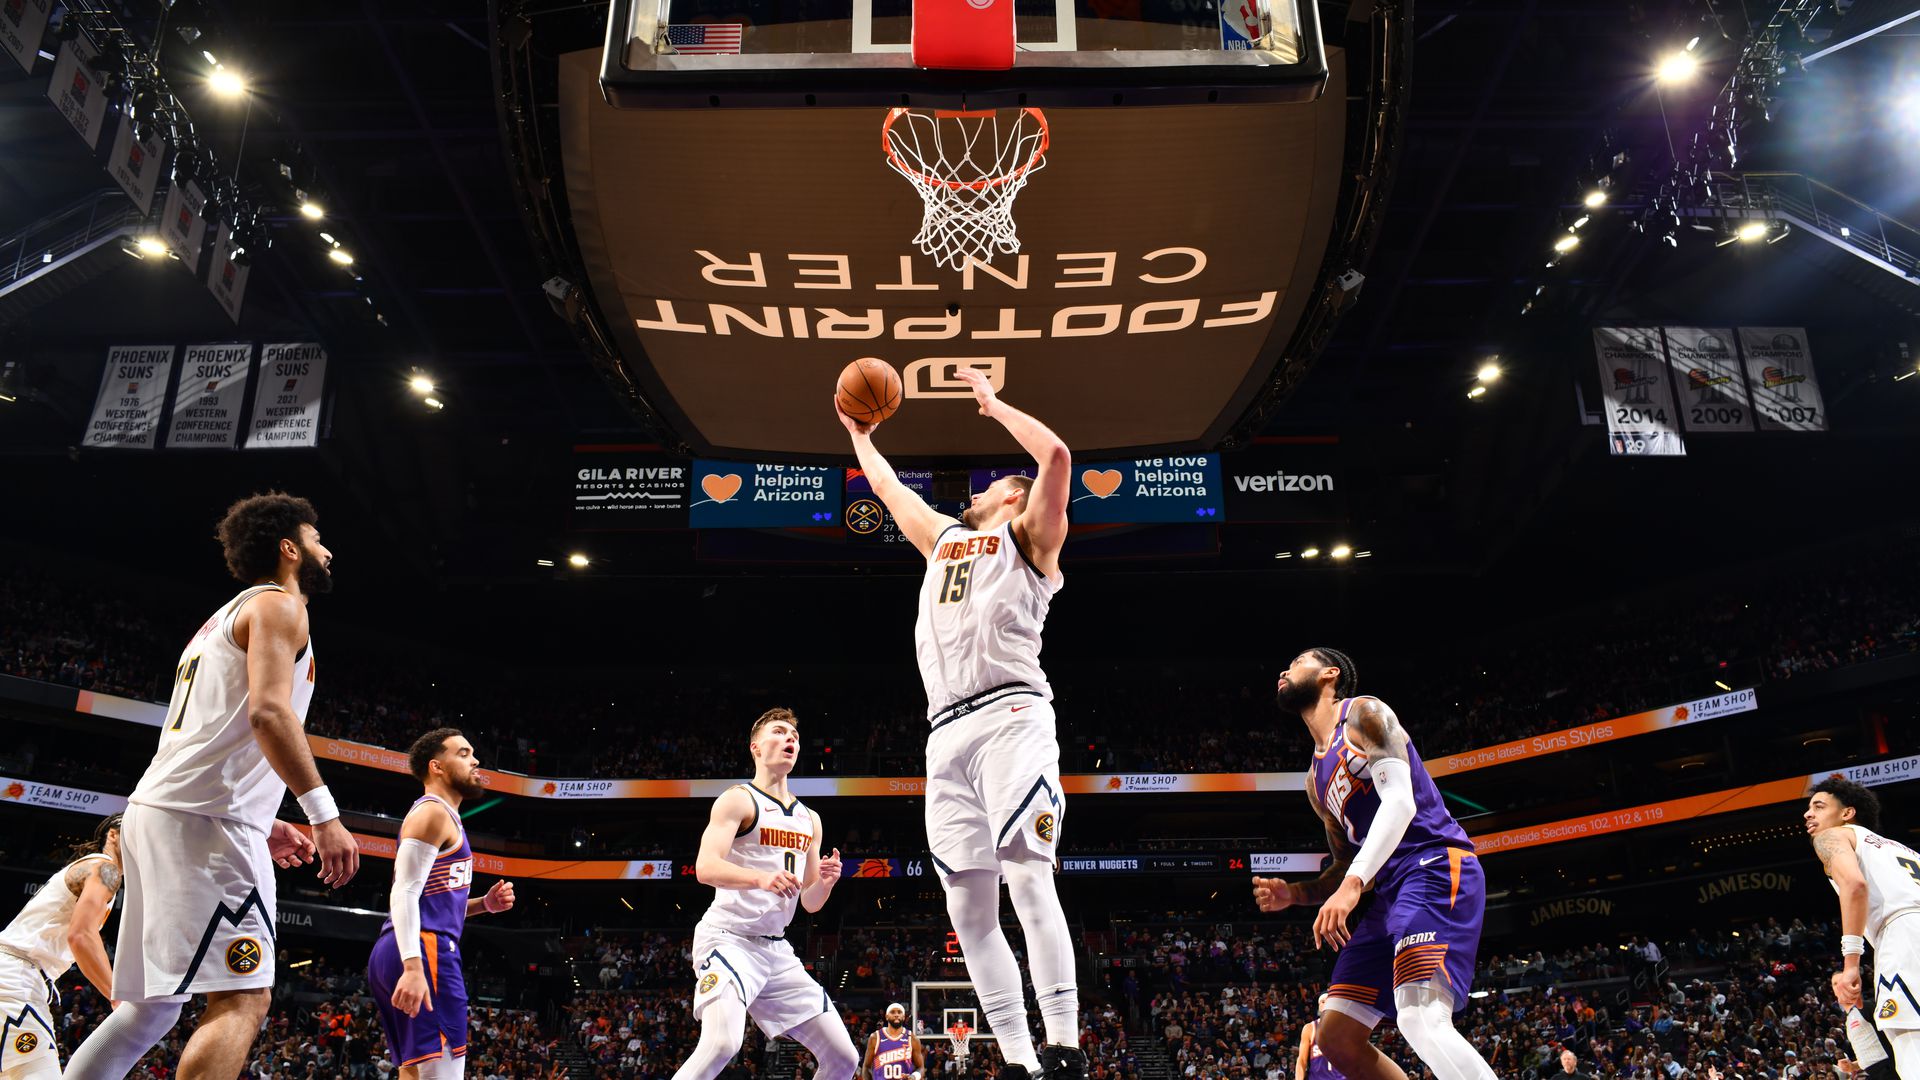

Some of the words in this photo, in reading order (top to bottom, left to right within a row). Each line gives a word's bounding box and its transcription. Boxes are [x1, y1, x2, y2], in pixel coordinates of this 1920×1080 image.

[1227, 40, 1247, 50] NBA
[694, 247, 1207, 291] CENTER
[635, 291, 1277, 340] FOOTPRINT
[110, 350, 170, 364] PHOENIX
[187, 349, 247, 363] PHOENIX
[266, 347, 323, 361] PHOENIX
[1604, 351, 1657, 359] CHAMPIONS
[1678, 351, 1731, 359] CHAMPIONS
[1752, 351, 1804, 359] CHAMPIONS
[118, 365, 154, 379] SUNS
[195, 364, 232, 378] SUNS
[275, 363, 309, 376] SUNS
[119, 397, 140, 407] 1976
[199, 396, 219, 407] 1993
[276, 395, 298, 404] 2021
[105, 409, 148, 419] WESTERN
[184, 408, 228, 418] WESTERN
[265, 407, 306, 416] WESTERN
[1616, 408, 1668, 424] 2014
[1691, 408, 1743, 425] 2009
[1766, 407, 1817, 424] 2007
[93, 421, 153, 431] CONFERENCE
[175, 420, 232, 431] CONFERENCE
[255, 419, 312, 429] CONFERENCE
[93, 433, 147, 444] CHAMPIONS
[175, 433, 228, 443] CHAMPIONS
[256, 431, 307, 442] CHAMPIONS
[1135, 458, 1164, 468] We
[577, 468, 622, 481] GILA
[625, 467, 683, 481] RIVER
[990, 470, 997, 479] 6
[1135, 468, 1203, 484] helping
[754, 473, 823, 489] helping
[1234, 471, 1334, 493] verizon
[753, 488, 825, 502] Arizona
[1135, 484, 1207, 497] Arizona
[959, 502, 966, 510] 8
[883, 523, 895, 532] 27
[883, 534, 895, 543] 32
[938, 560, 972, 605] 15
[1692, 698, 1720, 712] TEAM
[1724, 690, 1754, 706] SHOP
[1532, 735, 1568, 753] Suns
[1569, 725, 1614, 746] Styles
[327, 742, 358, 760] Shop
[359, 750, 379, 763] the
[1448, 754, 1477, 770] Shop
[1477, 751, 1496, 764] the
[1497, 743, 1527, 759] latest
[1849, 766, 1880, 780] TEAM
[1884, 759, 1918, 774] SHOP
[559, 783, 584, 791] TEAM
[587, 782, 613, 791] SHOP
[889, 780, 919, 792] Shop
[1125, 777, 1149, 785] TEAM
[1152, 776, 1178, 784] SHOP
[29, 785, 62, 799] TEAM
[65, 791, 100, 805] SHOP
[1474, 838, 1500, 851] cated
[1501, 831, 1541, 847] Outside
[1542, 822, 1588, 839] Sections
[1613, 813, 1632, 826] 112
[1633, 811, 1642, 823] &
[1644, 807, 1664, 821] 119
[354, 838, 392, 854] Outside
[478, 860, 486, 868] &
[488, 860, 504, 871] 119
[1263, 856, 1289, 865] SHOP
[784, 850, 796, 874] 0
[906, 861, 923, 876] 66
[1063, 860, 1097, 870] DENVER
[1099, 859, 1138, 870] NUGGETS
[1228, 858, 1244, 869] 24
[681, 865, 695, 876] 24
[1698, 872, 1792, 904] JAMESON
[1529, 898, 1614, 927] JAMESON
[879, 1048, 904, 1067] SUNS
[883, 1064, 902, 1080] 00
